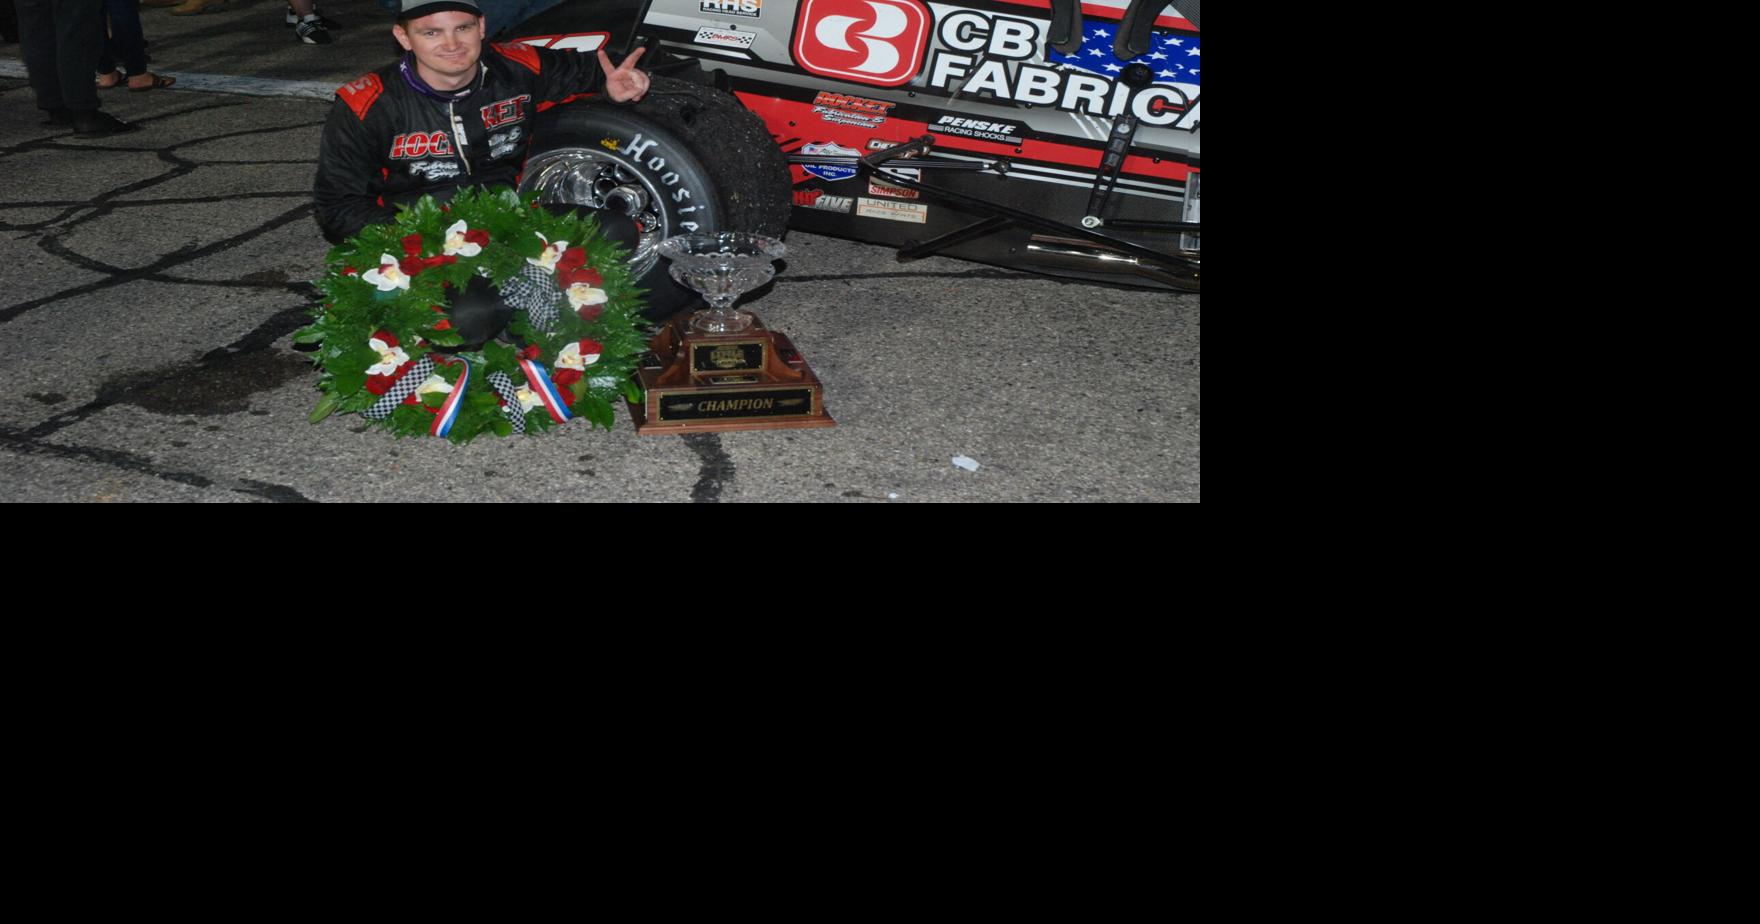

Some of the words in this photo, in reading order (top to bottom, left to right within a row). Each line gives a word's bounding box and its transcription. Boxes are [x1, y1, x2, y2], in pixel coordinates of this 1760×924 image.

[942, 13, 1035, 57] CB
[814, 91, 896, 115] ROCKET
[938, 116, 1016, 134] PENSKE
[944, 126, 972, 136] RACING
[974, 131, 1005, 141] SHOCKS
[868, 140, 899, 150] CHE
[818, 164, 856, 173] PRODUCTS
[621, 133, 705, 232] Hoosie
[871, 185, 917, 197] SIMPSON
[867, 199, 918, 211] UNITED
[697, 398, 773, 412] CHAMPION
